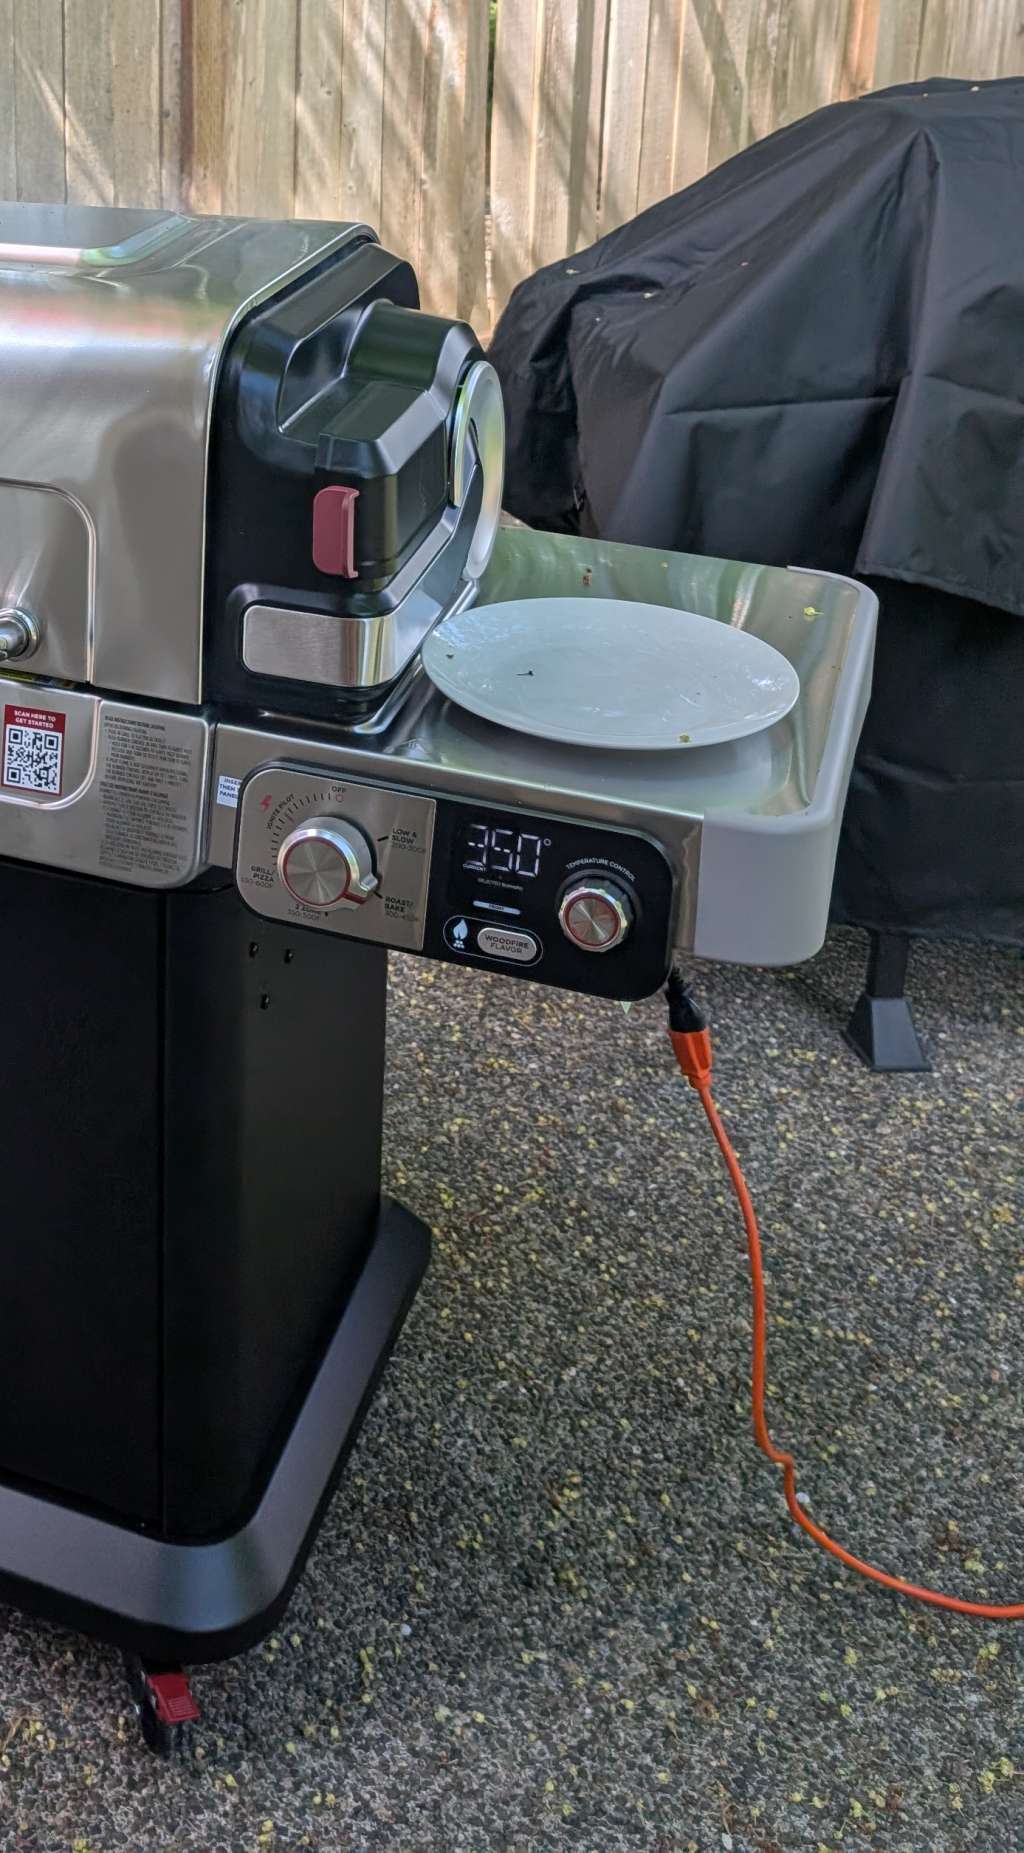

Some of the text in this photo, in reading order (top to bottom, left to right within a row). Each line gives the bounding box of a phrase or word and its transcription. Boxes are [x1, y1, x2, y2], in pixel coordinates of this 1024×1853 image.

[14, 710, 30, 718] SCAN
[28, 719, 54, 728] STARTED
[392, 827, 410, 837] LOW
[391, 835, 415, 845] SLOW
[565, 857, 636, 882] TEMPERATURE CONTROL
[253, 872, 274, 882] PIZZA
[485, 934, 529, 949] WOODFIRE
[490, 942, 523, 953] FLAVOR
